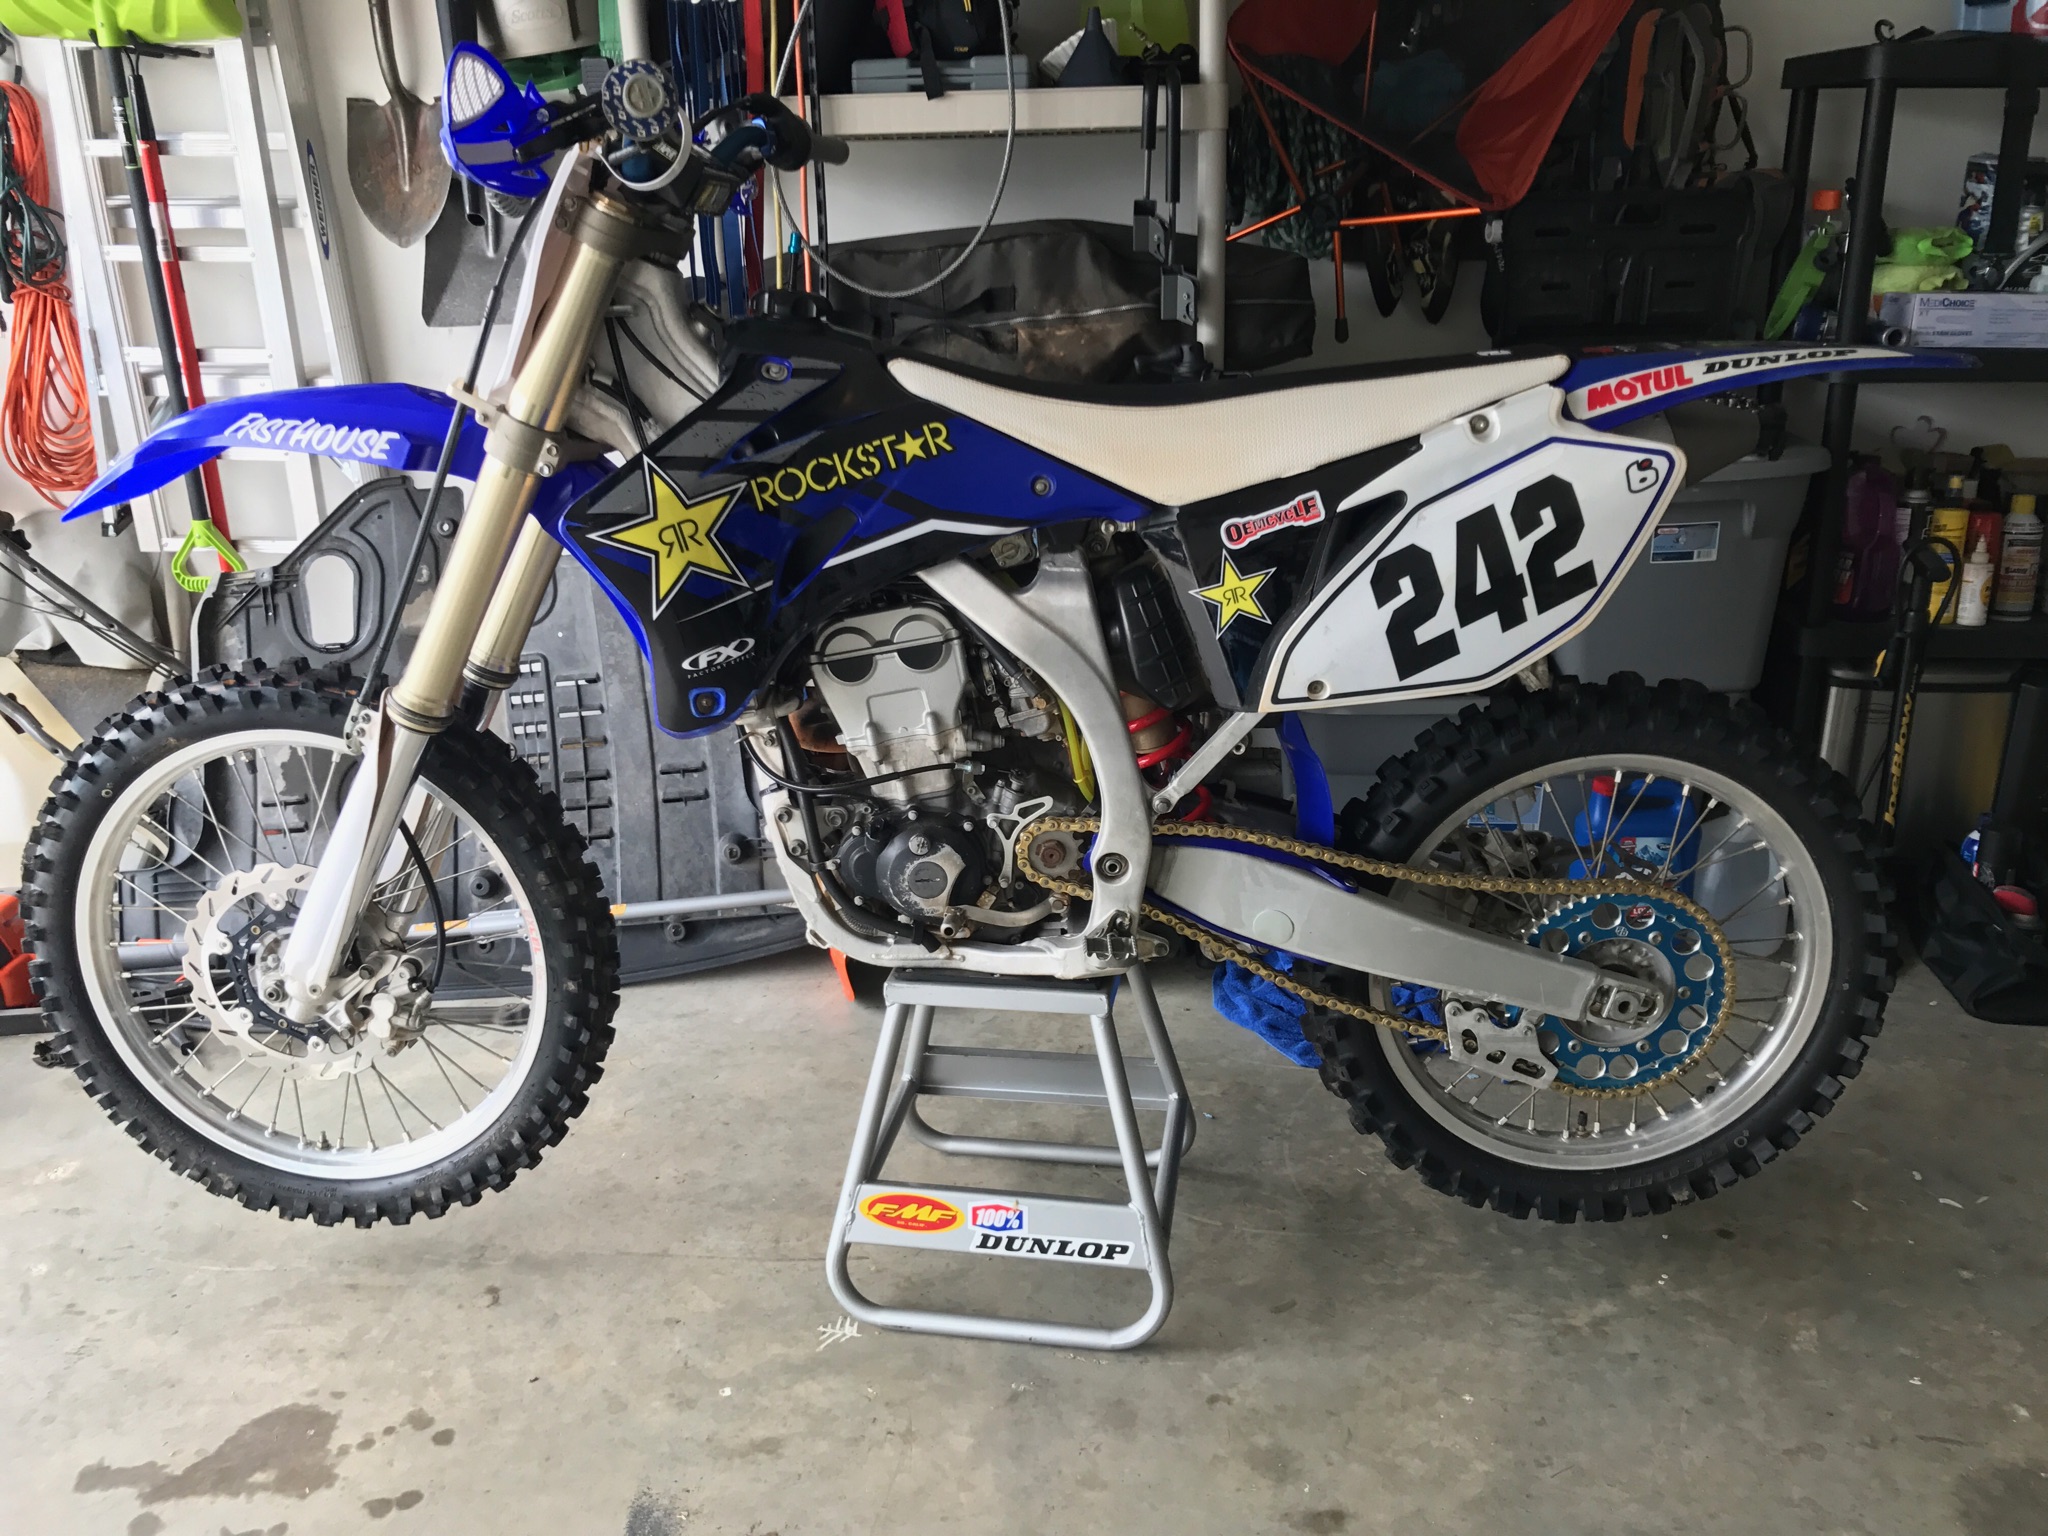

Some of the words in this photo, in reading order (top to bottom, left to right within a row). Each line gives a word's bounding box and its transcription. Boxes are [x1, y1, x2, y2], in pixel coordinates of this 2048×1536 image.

[310, 164, 327, 237] WERNER
[1702, 349, 1858, 375] DUNLOP
[1587, 364, 1693, 412] MOTUL
[223, 412, 401, 460] FASTHOUSE
[1370, 474, 1598, 682] 242
[687, 663, 727, 679] FACTORY
[867, 1202, 959, 1222] FMF
[975, 1208, 1021, 1229] 100%
[976, 1233, 1130, 1260] DUNLOP
